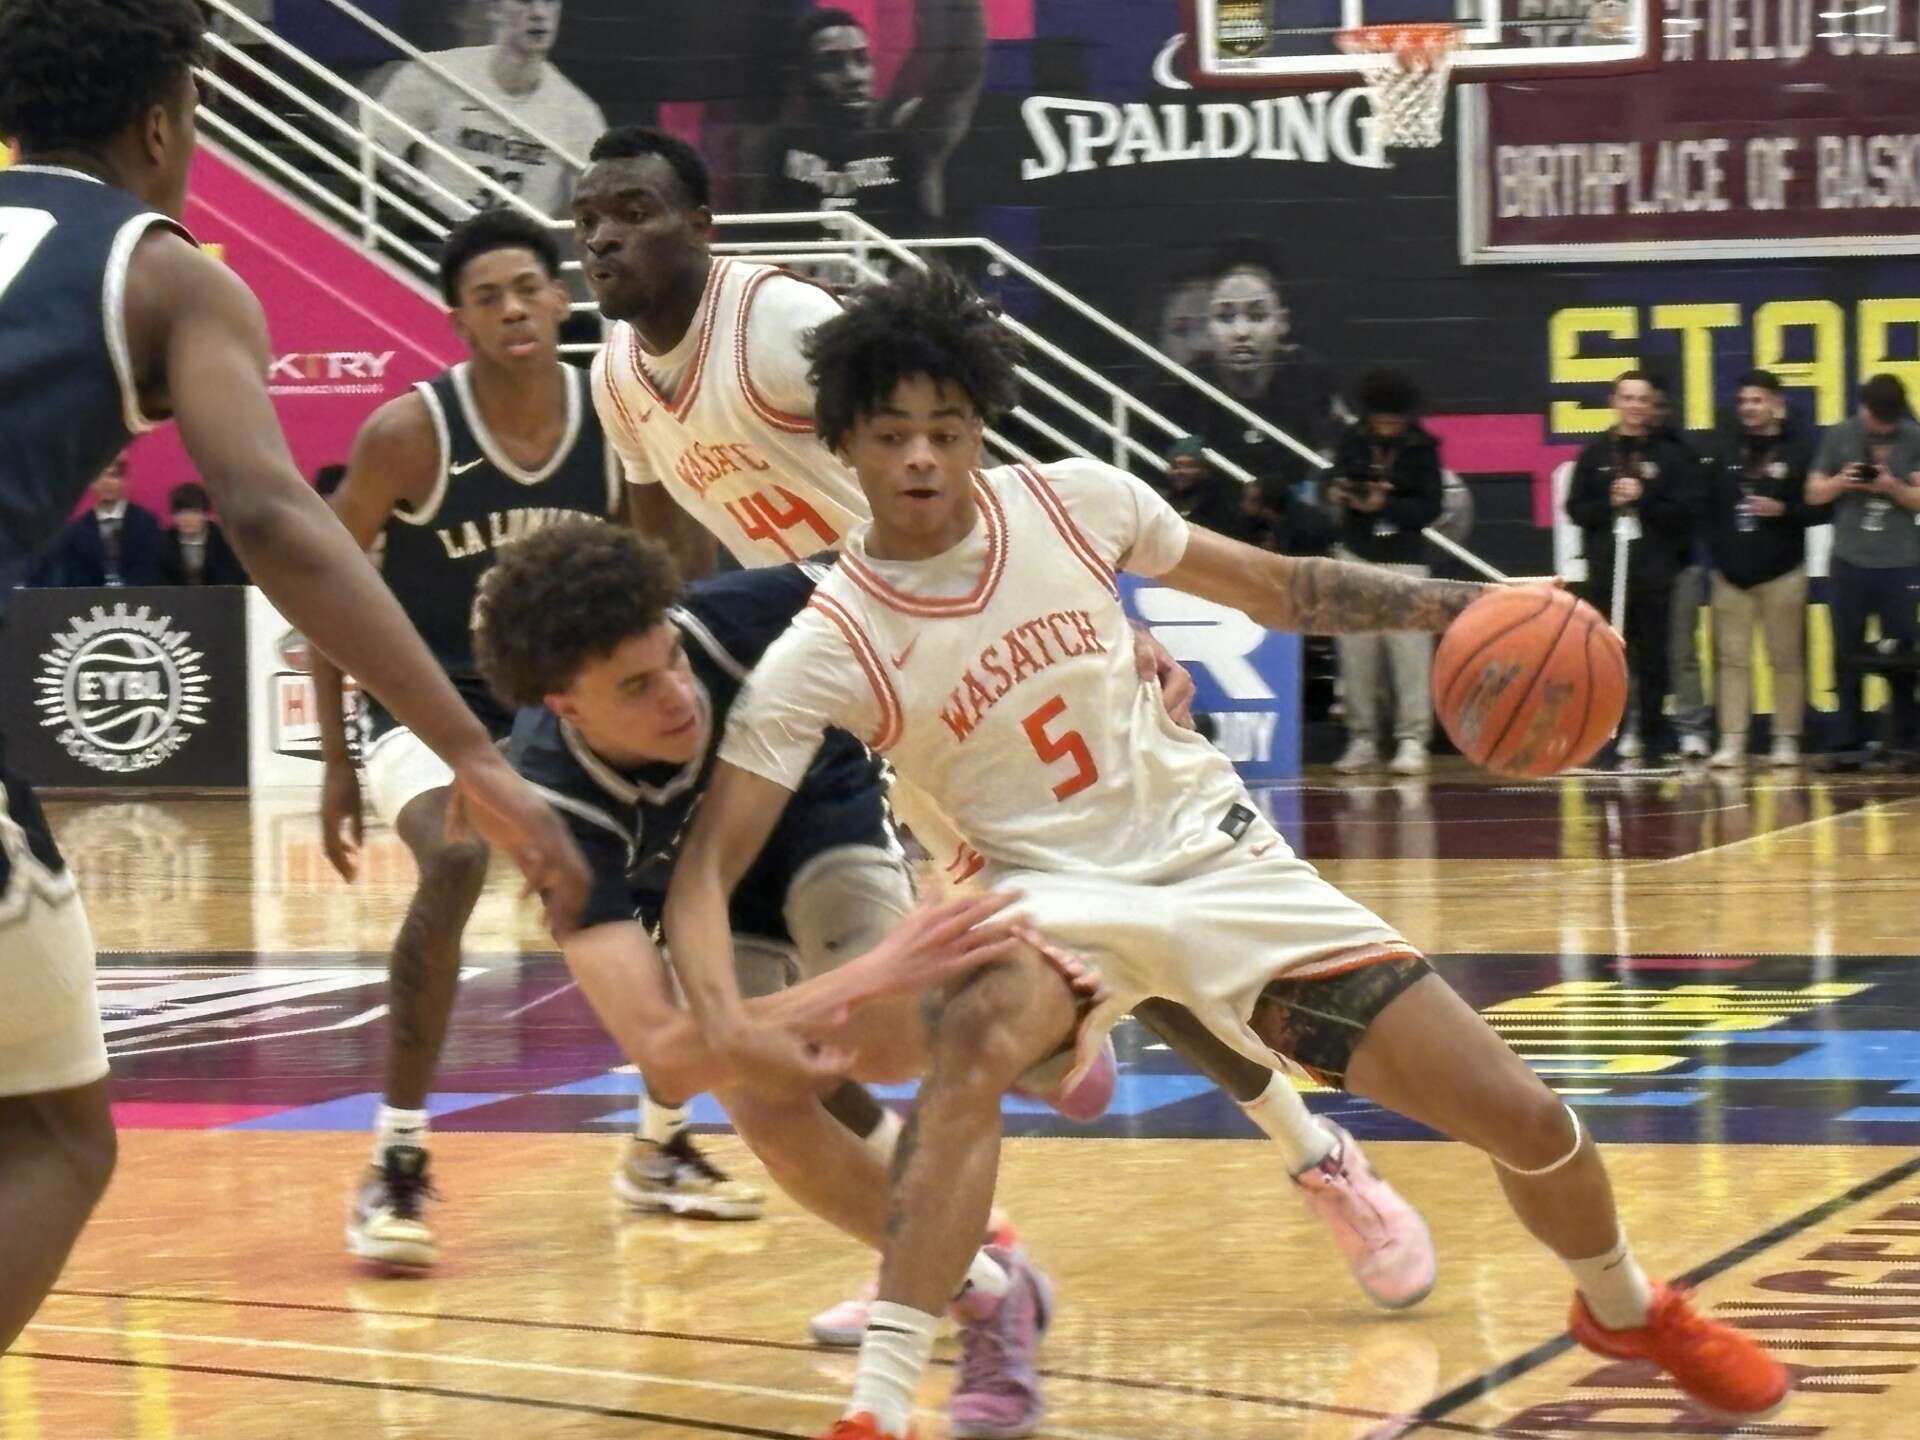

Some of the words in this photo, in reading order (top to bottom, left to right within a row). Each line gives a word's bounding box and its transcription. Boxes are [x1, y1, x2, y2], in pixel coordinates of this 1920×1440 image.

[1020, 87, 1397, 182] SPALDING
[1496, 138, 1731, 218] BIRTHPLACE
[1745, 136, 1800, 211] OF
[723, 483, 840, 563] 44
[938, 608, 1108, 743] WASATCH
[1021, 693, 1099, 802] 5
